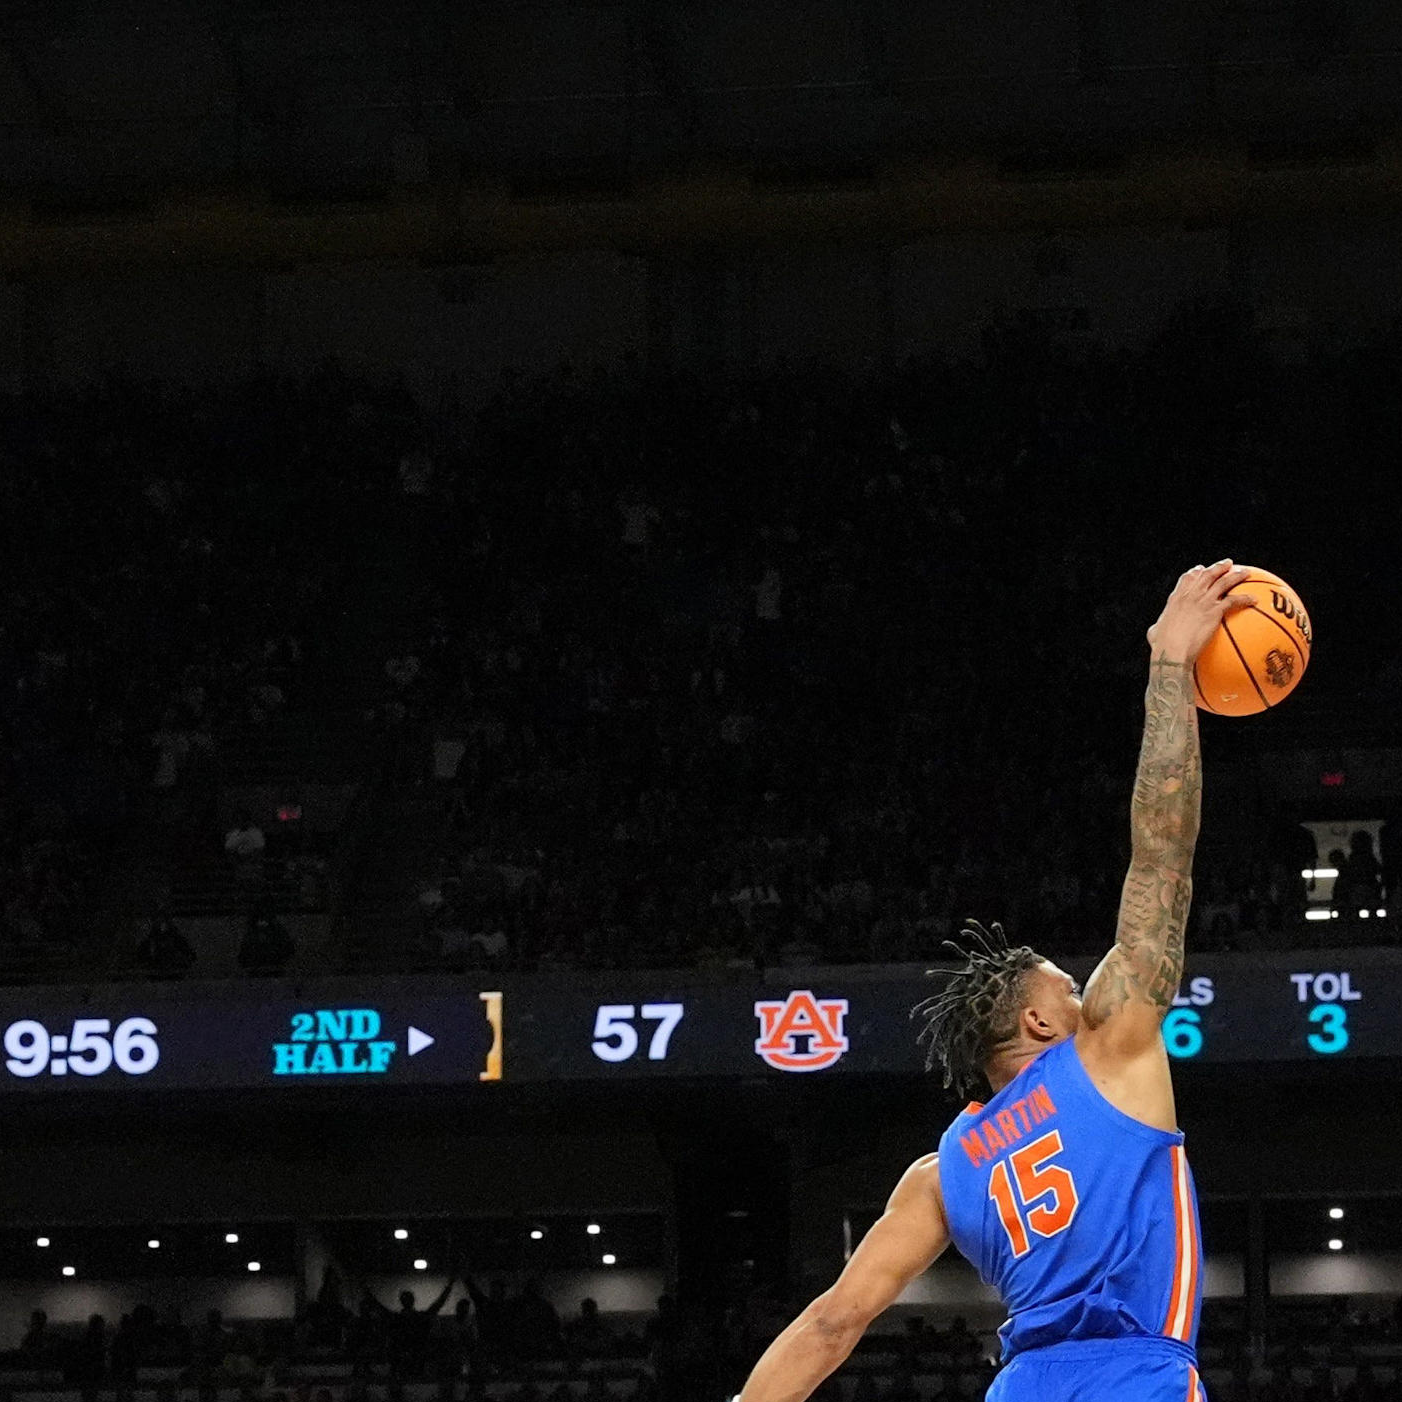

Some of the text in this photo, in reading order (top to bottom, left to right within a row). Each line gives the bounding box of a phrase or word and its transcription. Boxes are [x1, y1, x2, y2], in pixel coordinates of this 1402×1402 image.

[1171, 976, 1214, 1006] LS
[1290, 971, 1361, 1002] TOL
[3, 1016, 160, 1079] 9:56
[291, 1009, 382, 1043] 2ND
[591, 1003, 685, 1062] 57
[1162, 1008, 1203, 1058] 6
[1307, 1004, 1349, 1054] 3
[272, 1040, 396, 1075] HALF
[959, 1084, 1058, 1168] MARTIN
[988, 1129, 1079, 1258] 15
